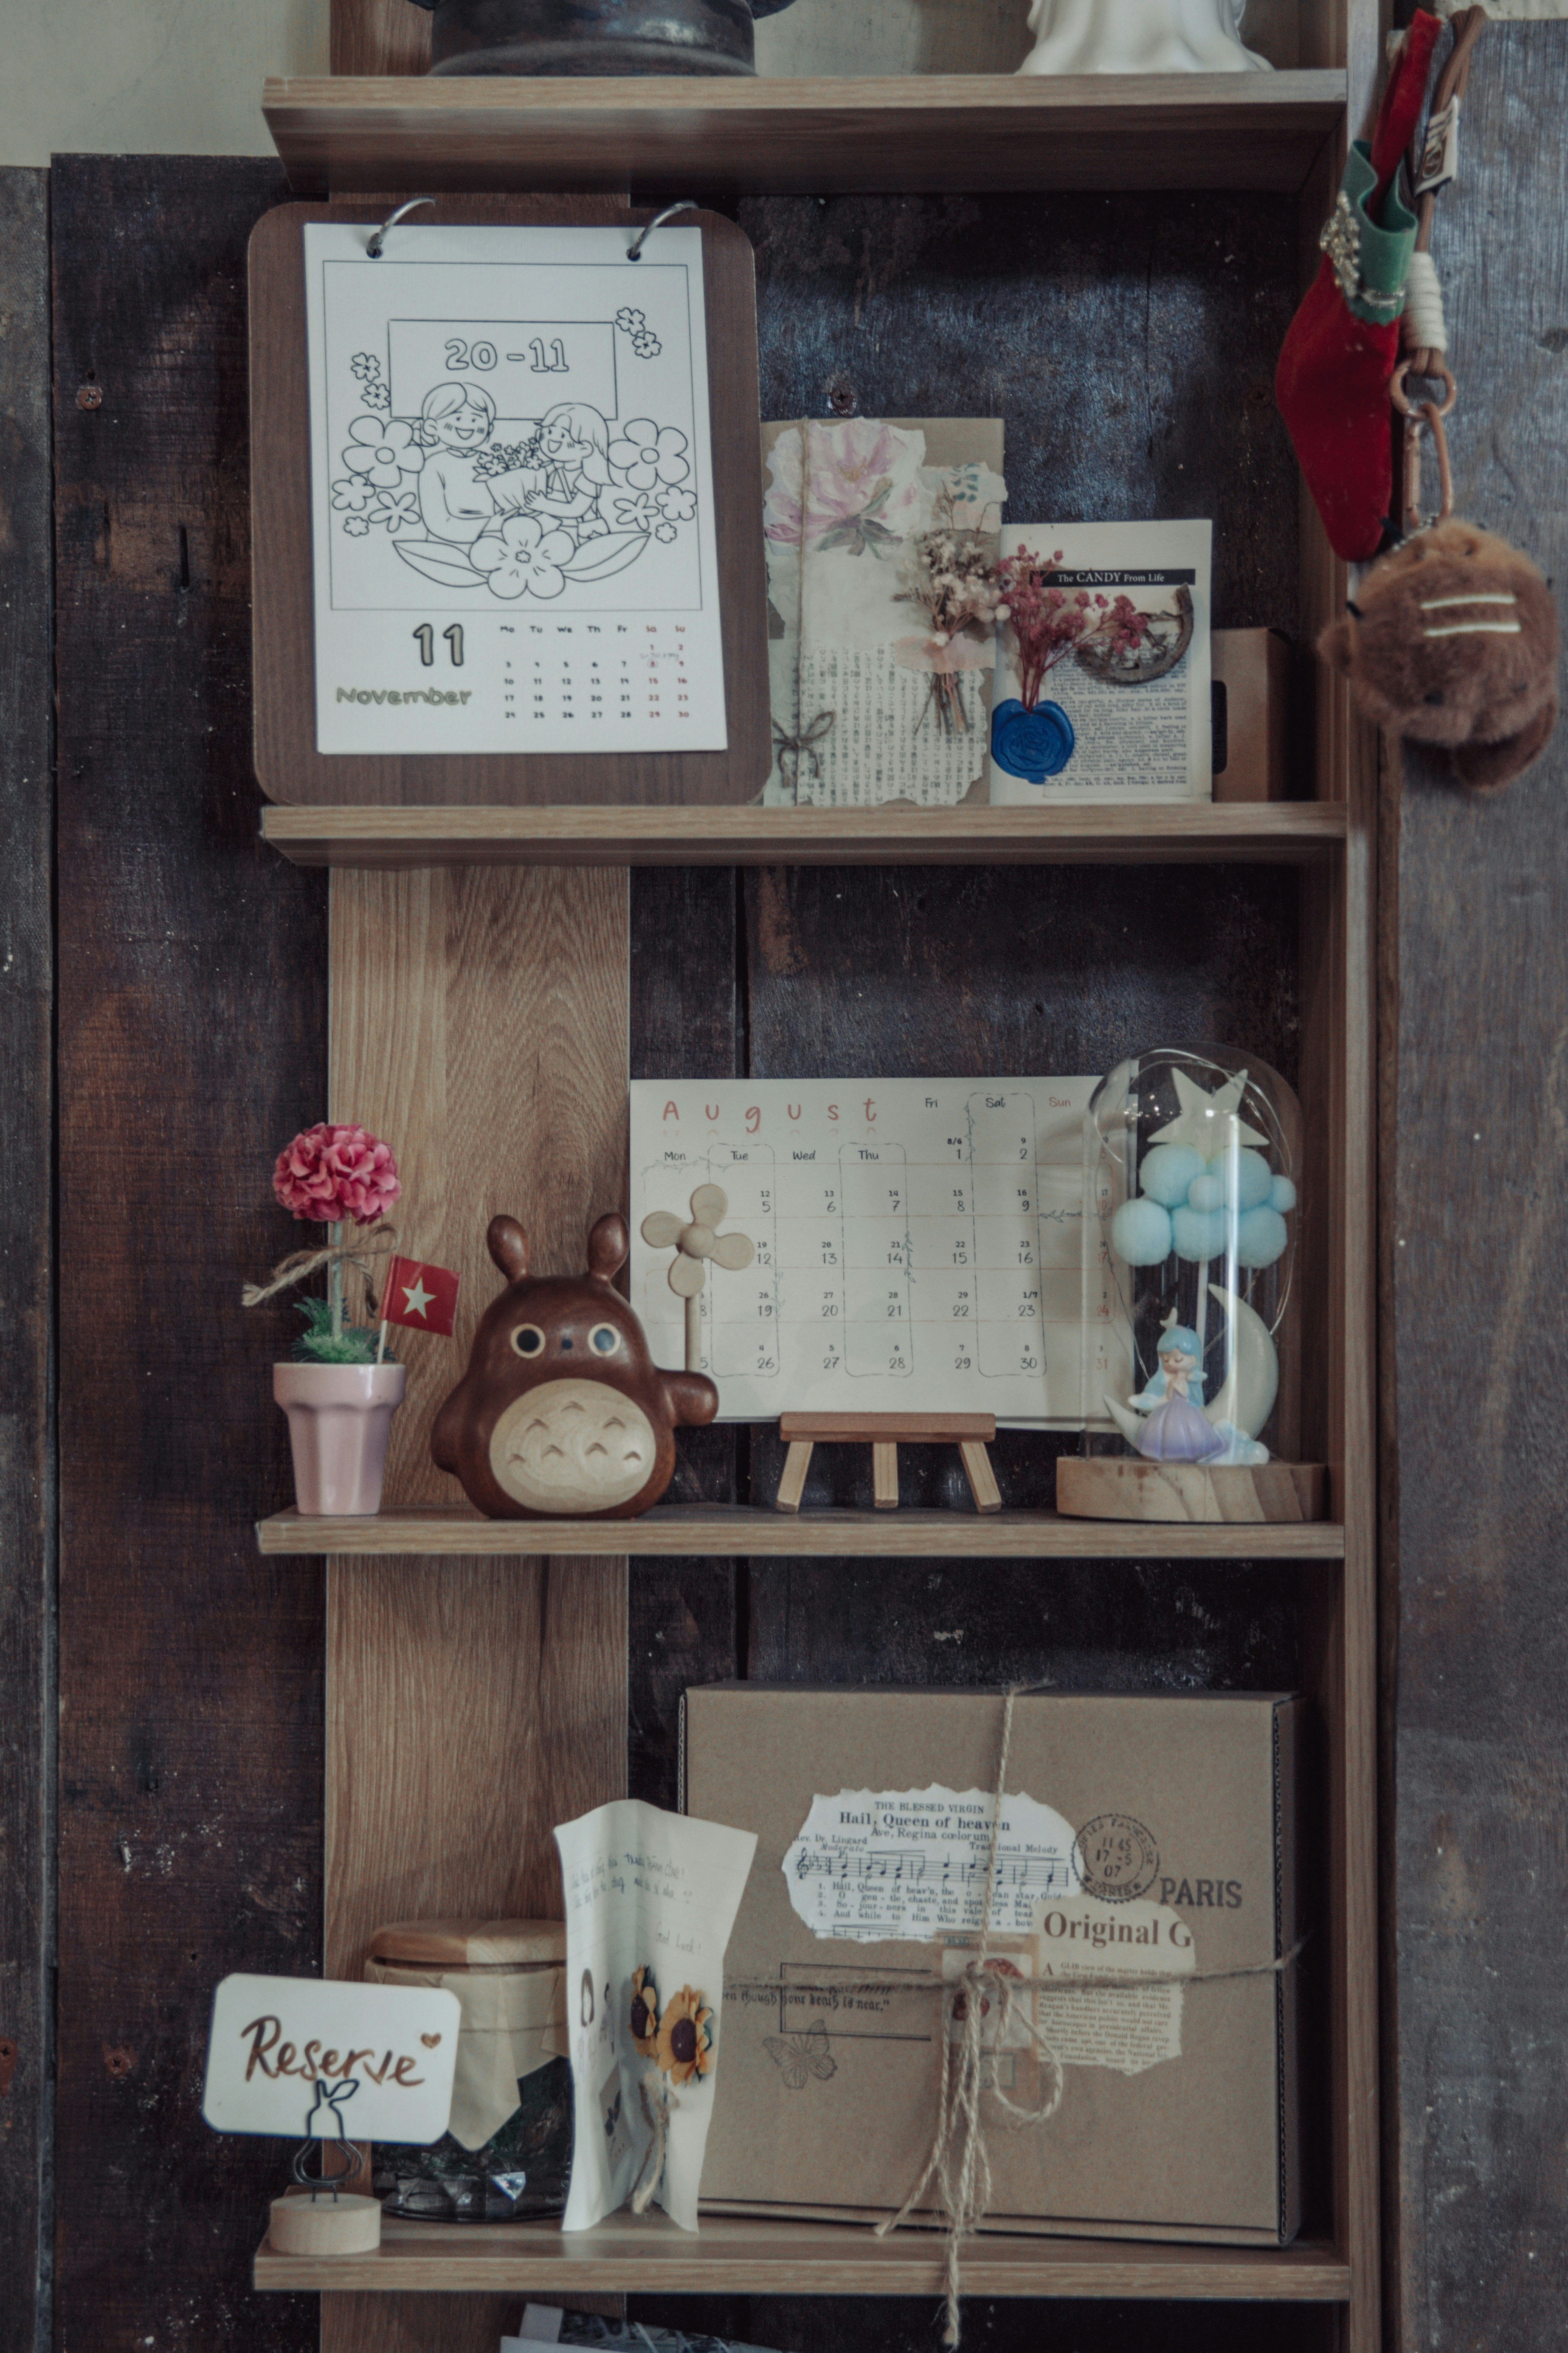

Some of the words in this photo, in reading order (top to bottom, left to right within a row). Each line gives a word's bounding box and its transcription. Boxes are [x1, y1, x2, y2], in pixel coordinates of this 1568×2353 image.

[1076, 572, 1121, 582] CANDY
[1124, 574, 1146, 582] From
[1149, 574, 1164, 582] Life
[413, 623, 464, 666] 11
[337, 687, 472, 705] November
[925, 1097, 938, 1108] Fri
[985, 1097, 1005, 1108] Sat
[1048, 1096, 1071, 1107] Sun
[664, 1151, 686, 1161] Mon
[730, 1150, 748, 1160] Tue
[793, 1150, 816, 1160] Wed
[858, 1149, 879, 1160] Thu
[957, 1149, 961, 1160] 1
[1019, 1148, 1028, 1160] 2
[762, 1201, 771, 1213] 5
[827, 1201, 836, 1212] 6
[892, 1200, 901, 1212] 7
[957, 1200, 965, 1212] 8
[1022, 1200, 1030, 1212] 9
[757, 1253, 771, 1265] 12
[822, 1253, 837, 1265] 13
[888, 1253, 903, 1264] 14
[952, 1252, 967, 1264] 15
[1019, 1252, 1033, 1264] 16
[758, 1305, 772, 1316] 19
[822, 1305, 838, 1317] 20
[887, 1305, 901, 1317] 21
[953, 1305, 969, 1317] 22
[1019, 1305, 1036, 1317] 23
[757, 1358, 774, 1369] 26
[823, 1357, 840, 1369] 27
[889, 1357, 905, 1369] 28
[955, 1357, 971, 1369] 29
[1021, 1357, 1037, 1370] 30
[875, 1801, 895, 1810] THE
[899, 1802, 944, 1812] BLESSED
[949, 1803, 984, 1814] VIRGIN
[839, 1811, 876, 1825] Hail,
[883, 1813, 929, 1828] Queen
[935, 1817, 951, 1827] of
[815, 1834, 827, 1843] Dr.
[832, 1834, 867, 1845] Lingard
[871, 1827, 893, 1838] Ave,
[898, 1828, 937, 1840] Regina
[969, 1841, 1021, 1852] Tradional
[1025, 1844, 1058, 1854] Melody
[833, 1882, 854, 1892] Hail,
[858, 1883, 884, 1893] Queen
[892, 1885, 901, 1893] of
[942, 1887, 954, 1896] the
[1160, 1877, 1242, 1908] PARIS
[992, 1899, 1008, 1908] less
[834, 1910, 850, 1918] And
[859, 1911, 881, 1919] while
[912, 1913, 930, 1922] Him
[937, 1913, 956, 1924] Who
[917, 1905, 926, 1913] in
[940, 1906, 957, 1914] this
[992, 1908, 1002, 1916] of
[1044, 1911, 1159, 1948] Original
[1042, 1962, 1053, 1975] A
[241, 2015, 425, 2086] Reserve
